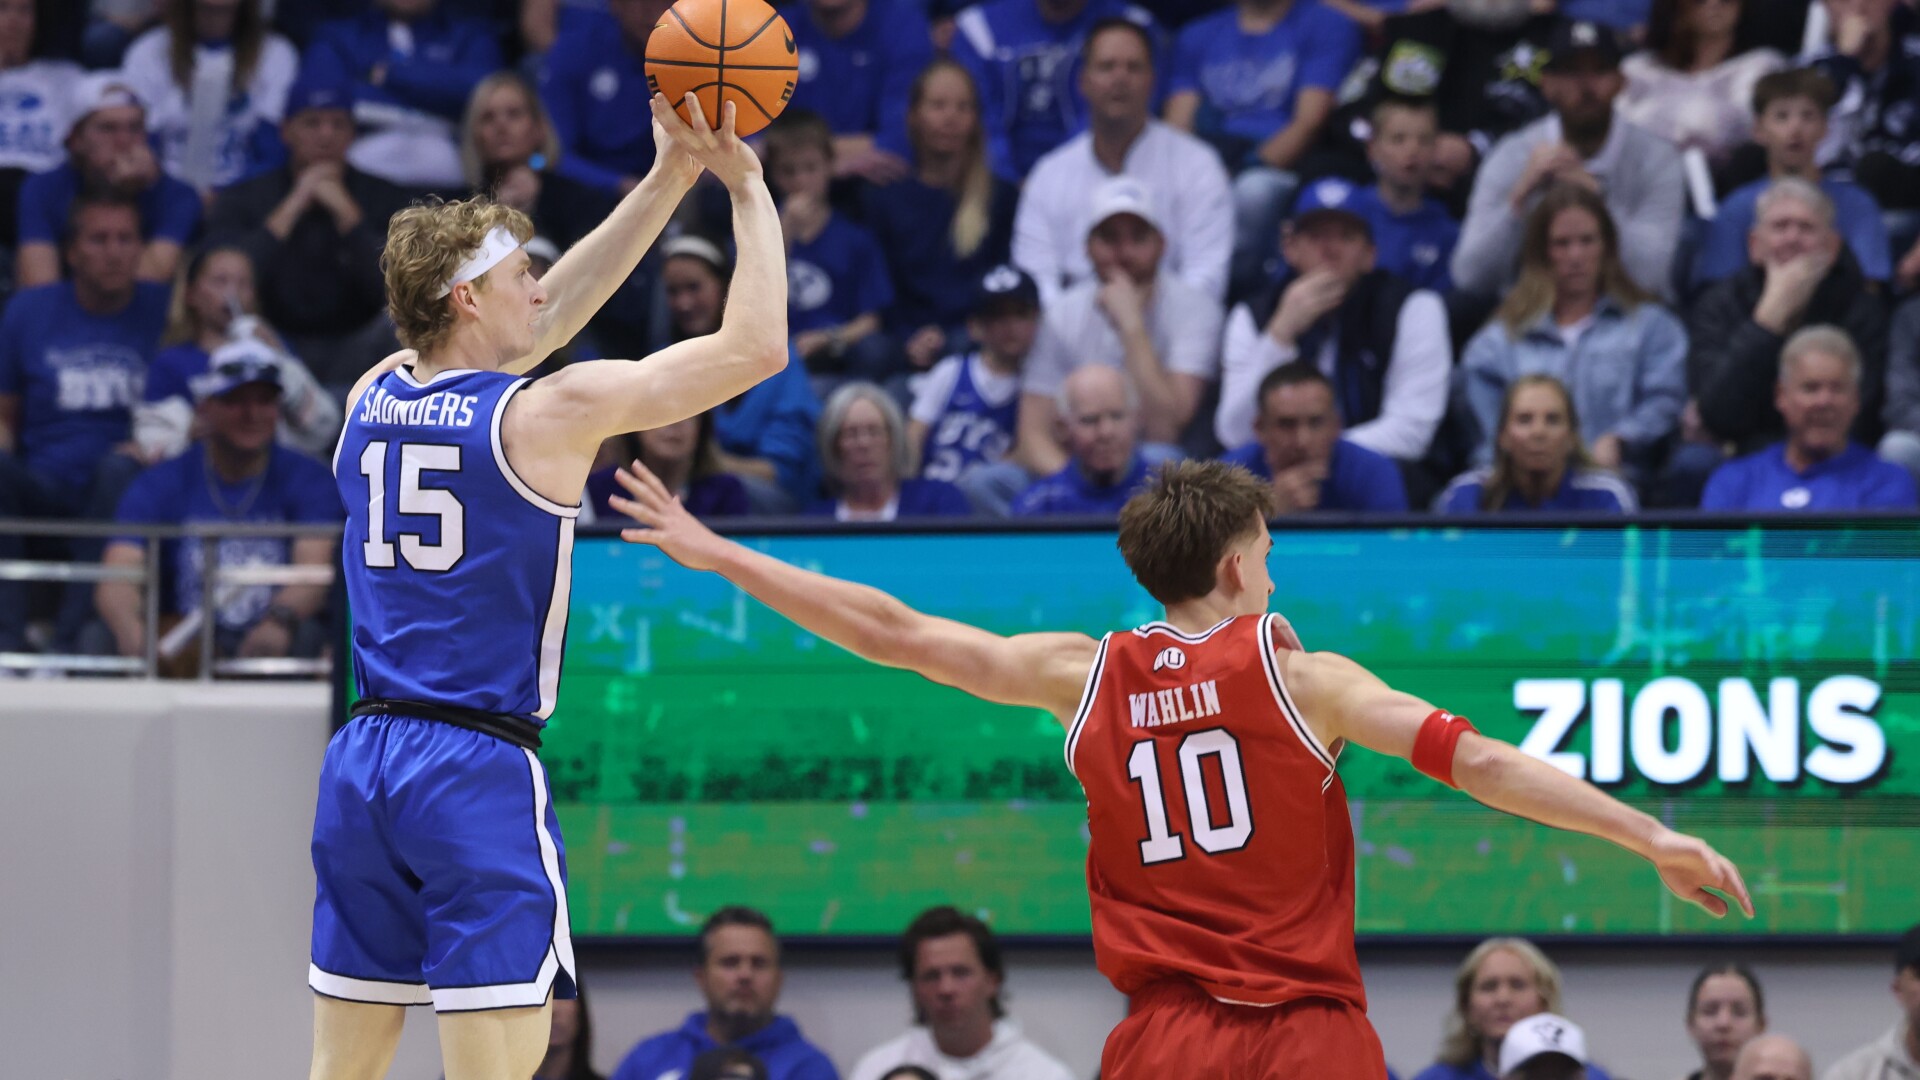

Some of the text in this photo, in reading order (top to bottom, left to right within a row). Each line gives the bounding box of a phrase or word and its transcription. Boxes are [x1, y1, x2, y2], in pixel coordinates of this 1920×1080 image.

[360, 386, 478, 427] SAUNDERS
[359, 440, 465, 572] 15
[1128, 679, 1222, 728] WAHLIN
[1513, 674, 1886, 784] ZIONS
[1126, 726, 1255, 867] 10
